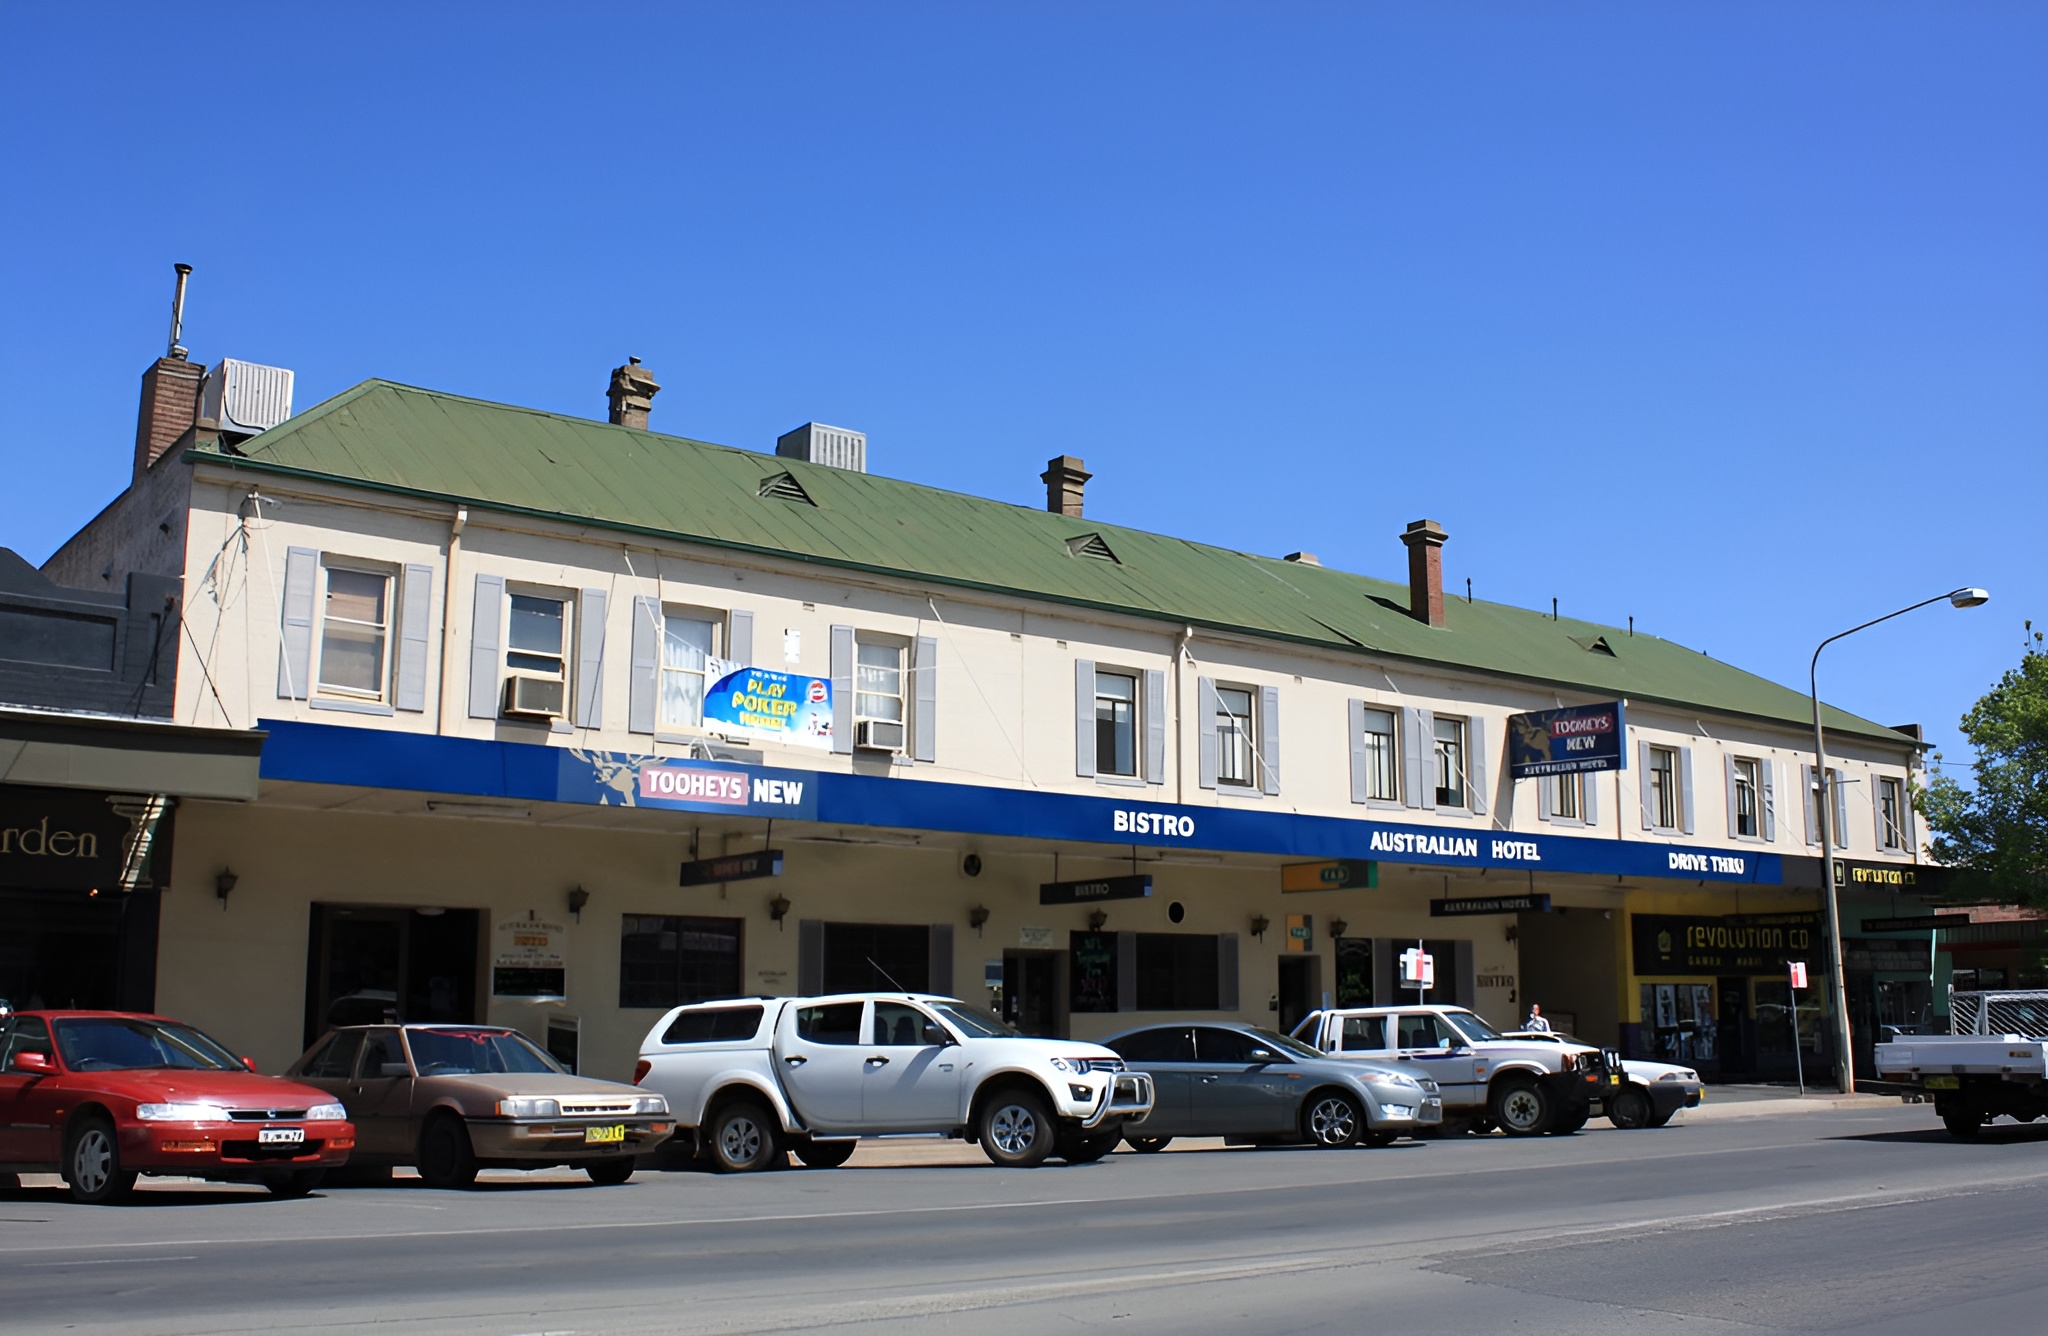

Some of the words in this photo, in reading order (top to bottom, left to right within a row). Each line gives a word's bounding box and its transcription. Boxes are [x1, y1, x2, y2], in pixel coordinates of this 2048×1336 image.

[748, 679, 786, 698] PLAY
[732, 691, 797, 716] POKER
[1554, 716, 1609, 735] TOOHEYS
[1566, 735, 1596, 751] NEW
[647, 771, 742, 799] TOOHEYS
[753, 778, 804, 805] NEW
[1114, 810, 1195, 837] BISTRO
[2, 816, 98, 857] rden
[1370, 831, 1477, 857] AUSTRALIAN
[1492, 840, 1541, 861] HOTEL
[1669, 853, 1708, 872] DRIVE
[1710, 856, 1744, 874] THRU
